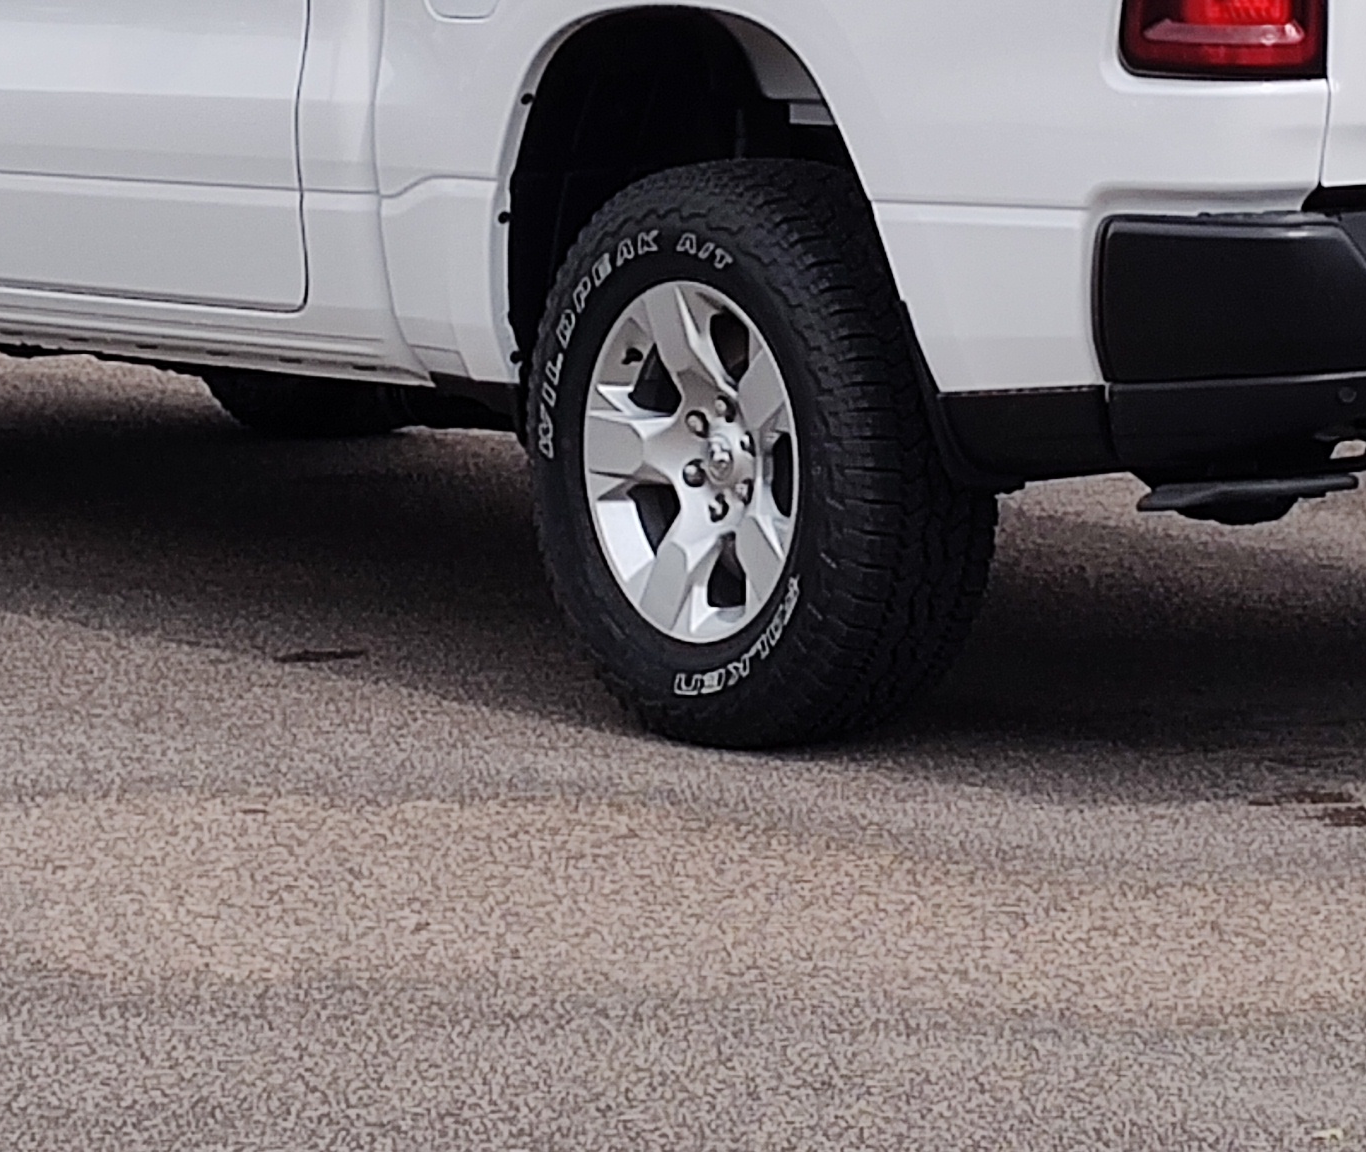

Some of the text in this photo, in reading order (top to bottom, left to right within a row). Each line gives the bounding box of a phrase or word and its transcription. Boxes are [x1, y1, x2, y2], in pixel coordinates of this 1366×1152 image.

[538, 230, 734, 460] WILDPEAK A/T
[673, 573, 801, 696] FALKEN
